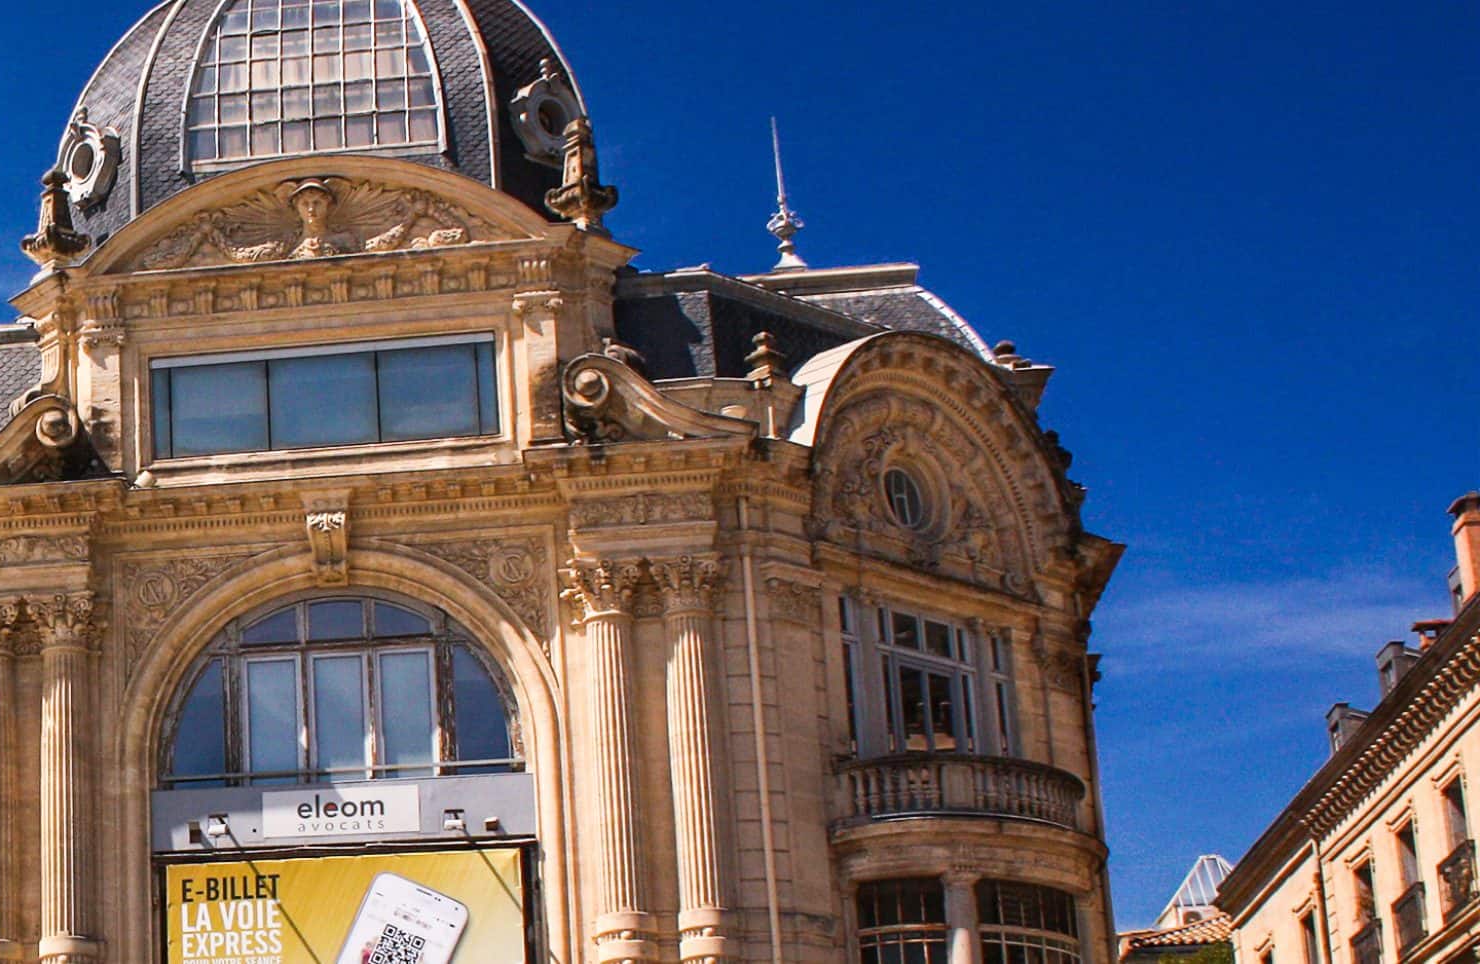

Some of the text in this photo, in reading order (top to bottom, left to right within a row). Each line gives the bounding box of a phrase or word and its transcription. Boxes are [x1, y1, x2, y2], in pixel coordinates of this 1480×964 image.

[297, 794, 385, 819] eleom
[297, 819, 385, 832] avocats
[182, 874, 280, 902] E-BILLET
[182, 899, 282, 932] LA VOIE
[182, 929, 282, 957] EXPRESS
